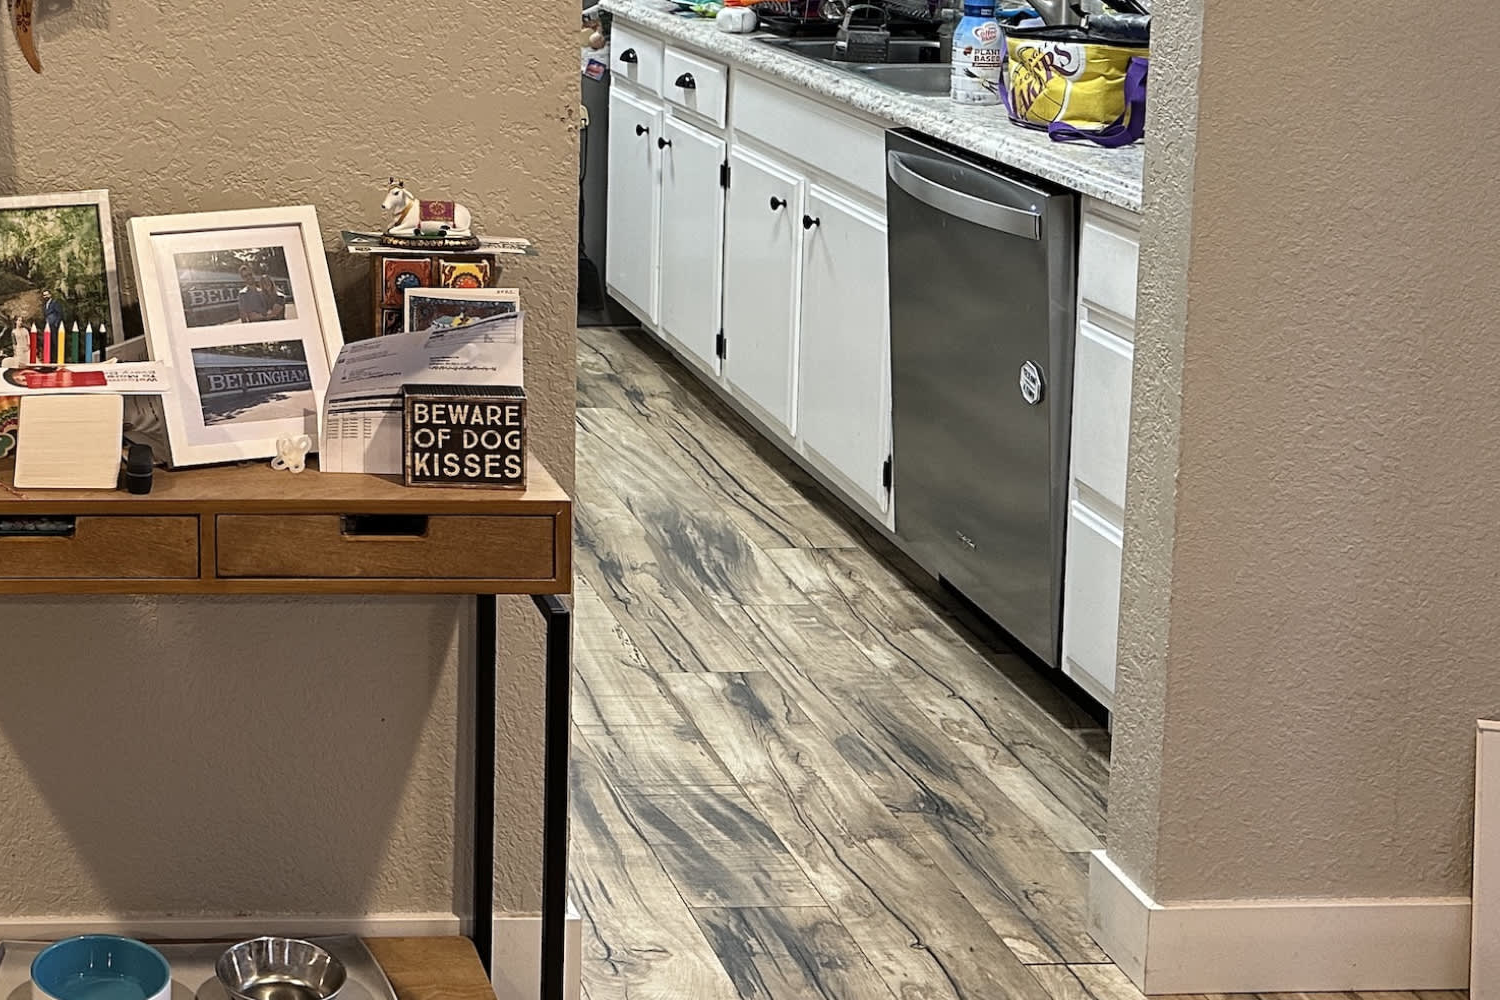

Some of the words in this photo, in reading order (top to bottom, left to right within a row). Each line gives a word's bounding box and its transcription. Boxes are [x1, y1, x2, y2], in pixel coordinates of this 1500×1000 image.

[974, 48, 1001, 56] PLANT
[206, 368, 309, 391] BELLINGHAM
[414, 403, 520, 426] BEWARE
[414, 428, 451, 449] OF
[463, 429, 520, 450] DOG
[414, 452, 521, 478] KISSES
